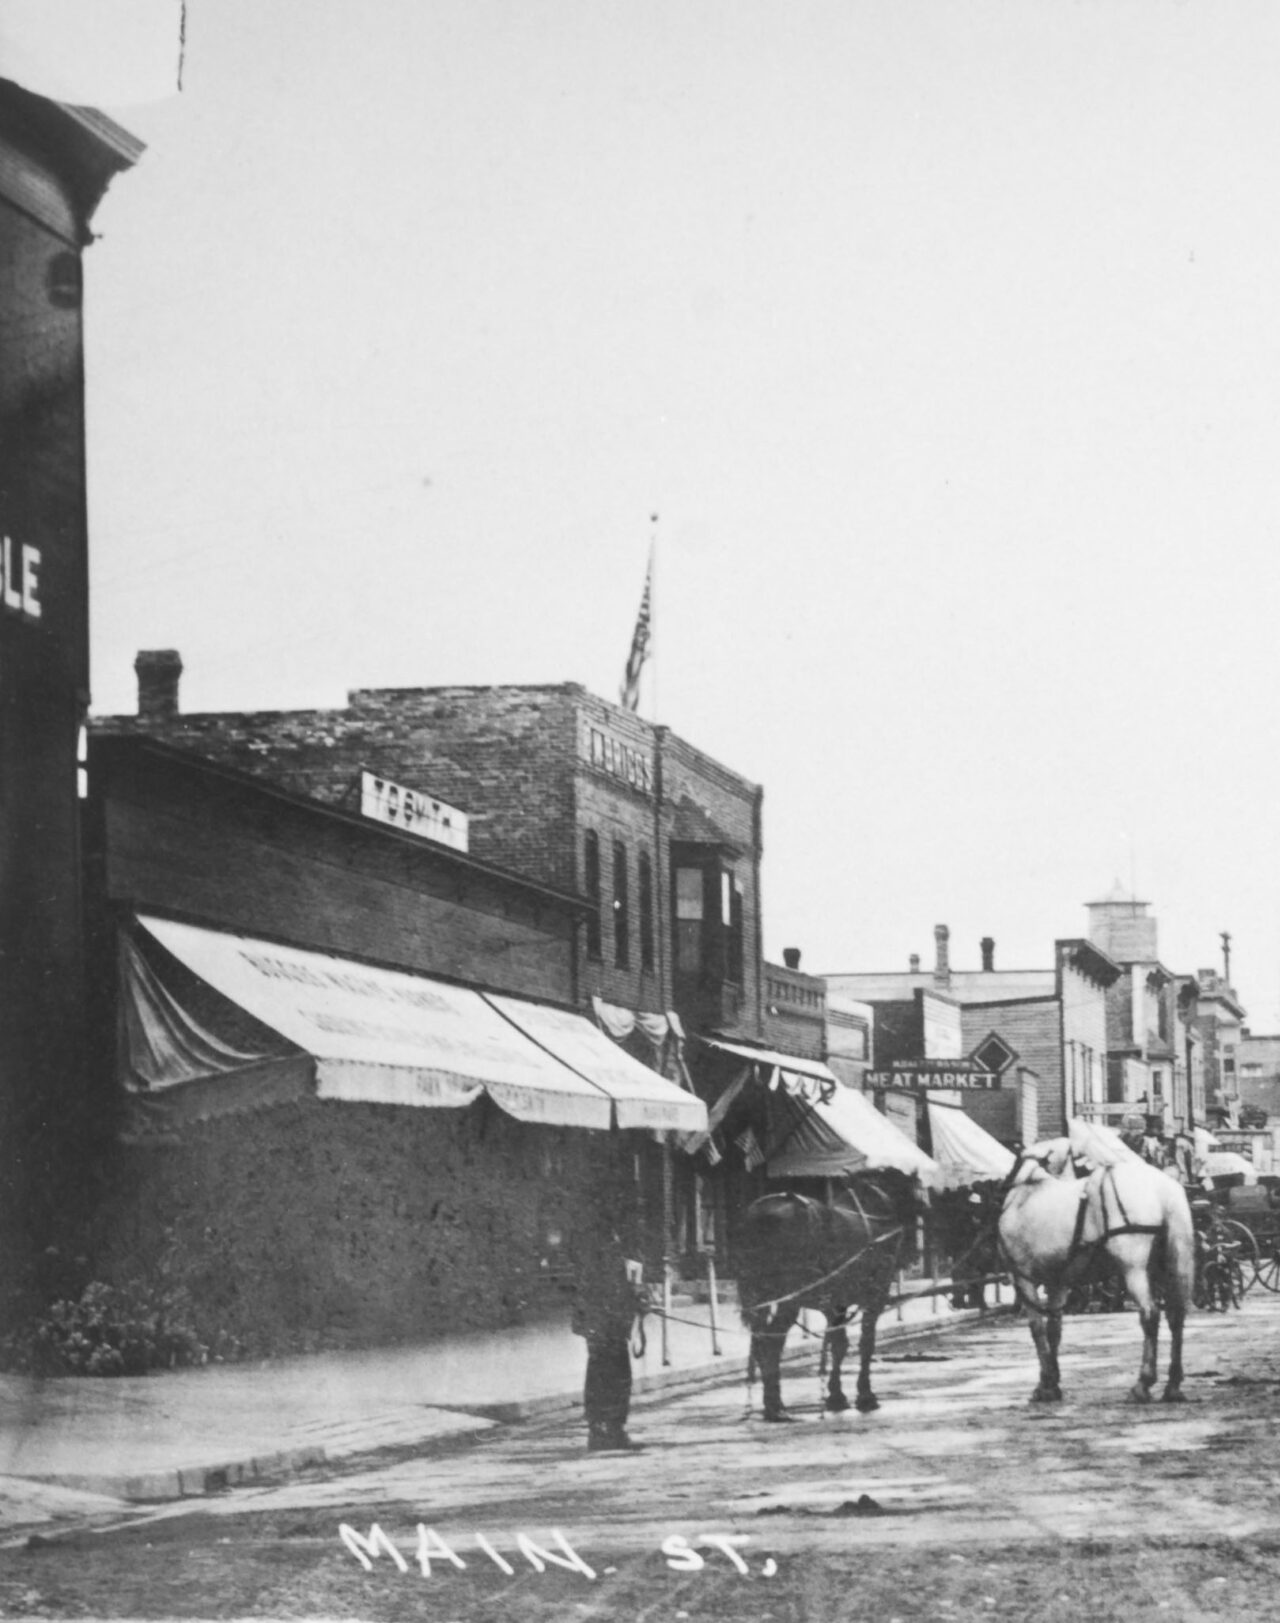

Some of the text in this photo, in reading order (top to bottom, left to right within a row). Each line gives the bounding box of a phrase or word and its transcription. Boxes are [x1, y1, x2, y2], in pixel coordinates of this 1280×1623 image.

[0, 535, 41, 617] LE
[867, 1072, 997, 1088] MEAT MARKET
